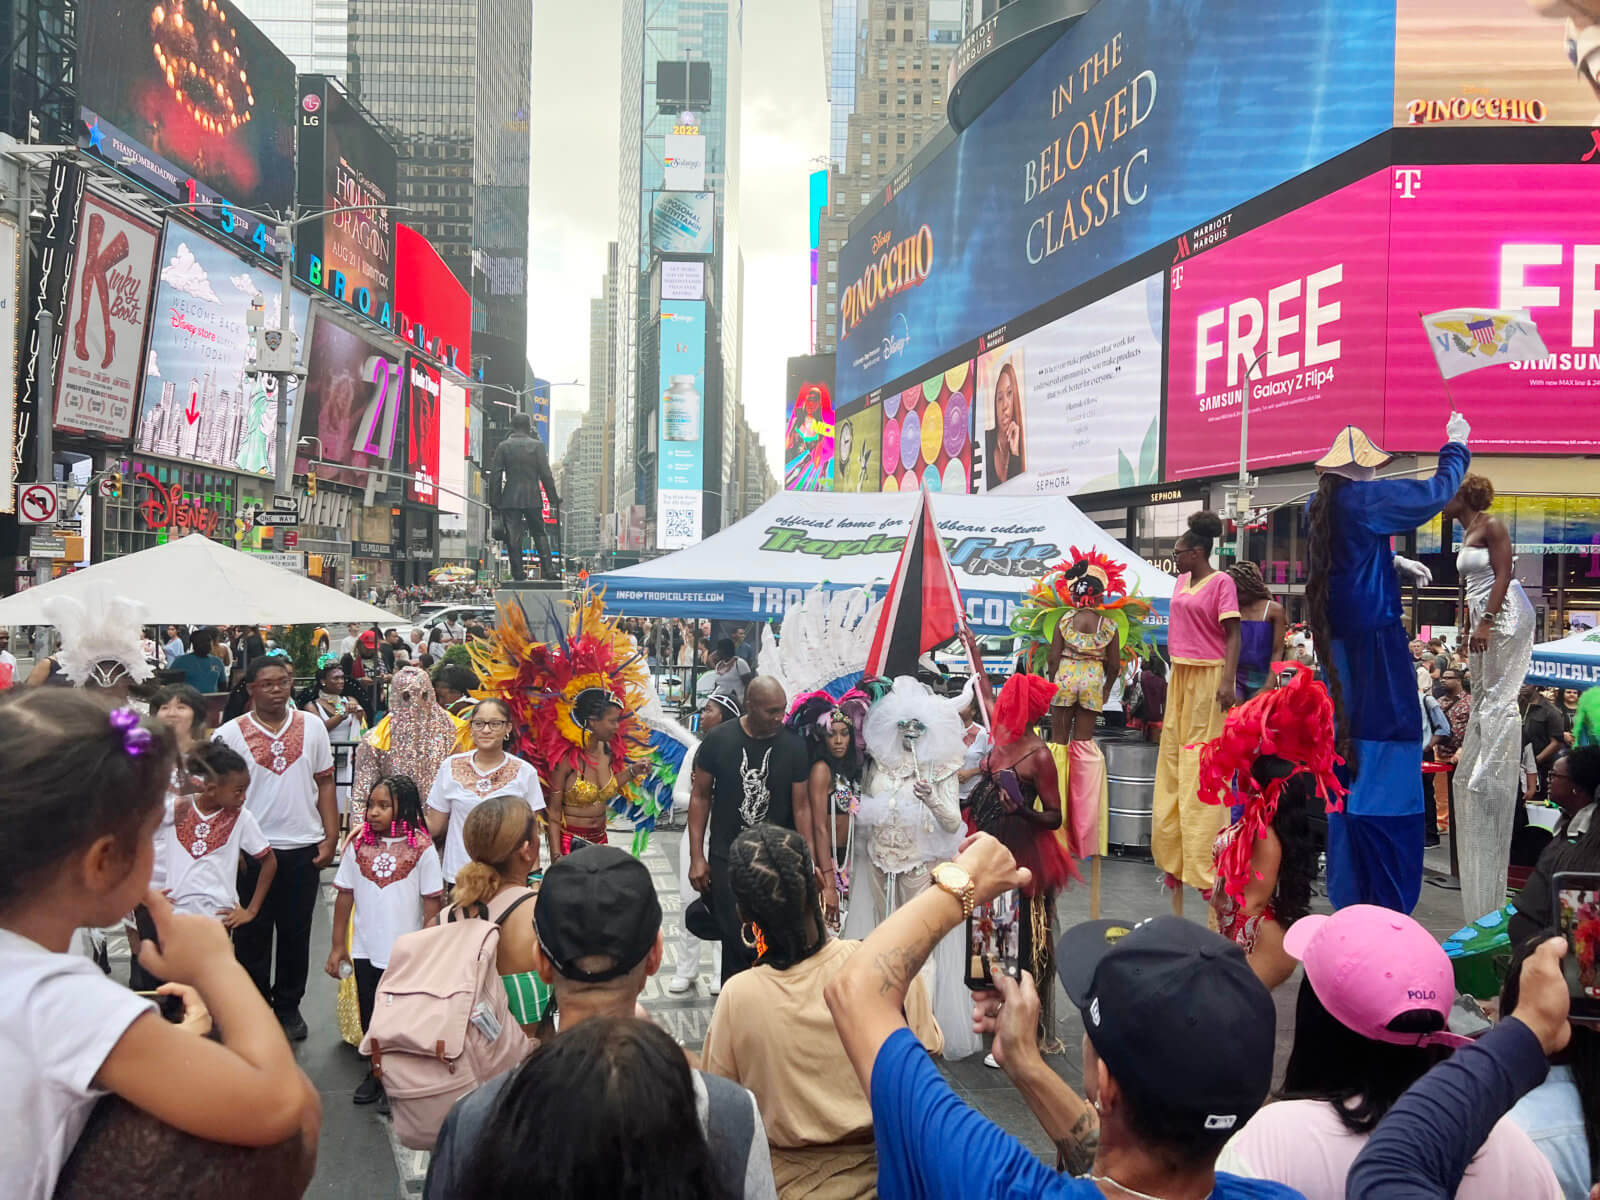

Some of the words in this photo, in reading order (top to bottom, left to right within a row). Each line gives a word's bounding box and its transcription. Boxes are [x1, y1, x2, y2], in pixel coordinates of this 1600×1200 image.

[957, 16, 999, 58] MARRIOTT
[957, 35, 992, 73] MARQUIS
[1051, 75, 1074, 120] IN
[1080, 32, 1123, 94] THE
[303, 116, 319, 126] LG
[1406, 97, 1548, 125] PINOCCHIO
[673, 126, 699, 135] 2022
[1024, 69, 1157, 205] BELOVED
[1026, 149, 1148, 265] CLASSIC
[333, 197, 390, 265] DRAGON
[1193, 213, 1233, 240] MARRIOTT
[1193, 227, 1228, 252] MARQUIS
[840, 224, 934, 340] PINOCCHIO
[198, 327, 217, 342] store
[1195, 263, 1343, 396] FREE
[1199, 389, 1244, 412] SAMSUN
[1253, 378, 1295, 400] Galaxy
[1296, 374, 1304, 390] Z
[1305, 366, 1335, 390] Flip4
[353, 356, 405, 460] 21
[1036, 476, 1071, 491] SEPHORA
[1151, 490, 1182, 502] SEPHORA
[775, 515, 834, 529] official
[837, 518, 877, 529] home
[879, 518, 904, 530] for
[990, 524, 1047, 535] culture
[951, 537, 1062, 566] Fete
[616, 590, 725, 602] INFO@TROPICALFETE.COM
[1407, 990, 1436, 1000] POLO
